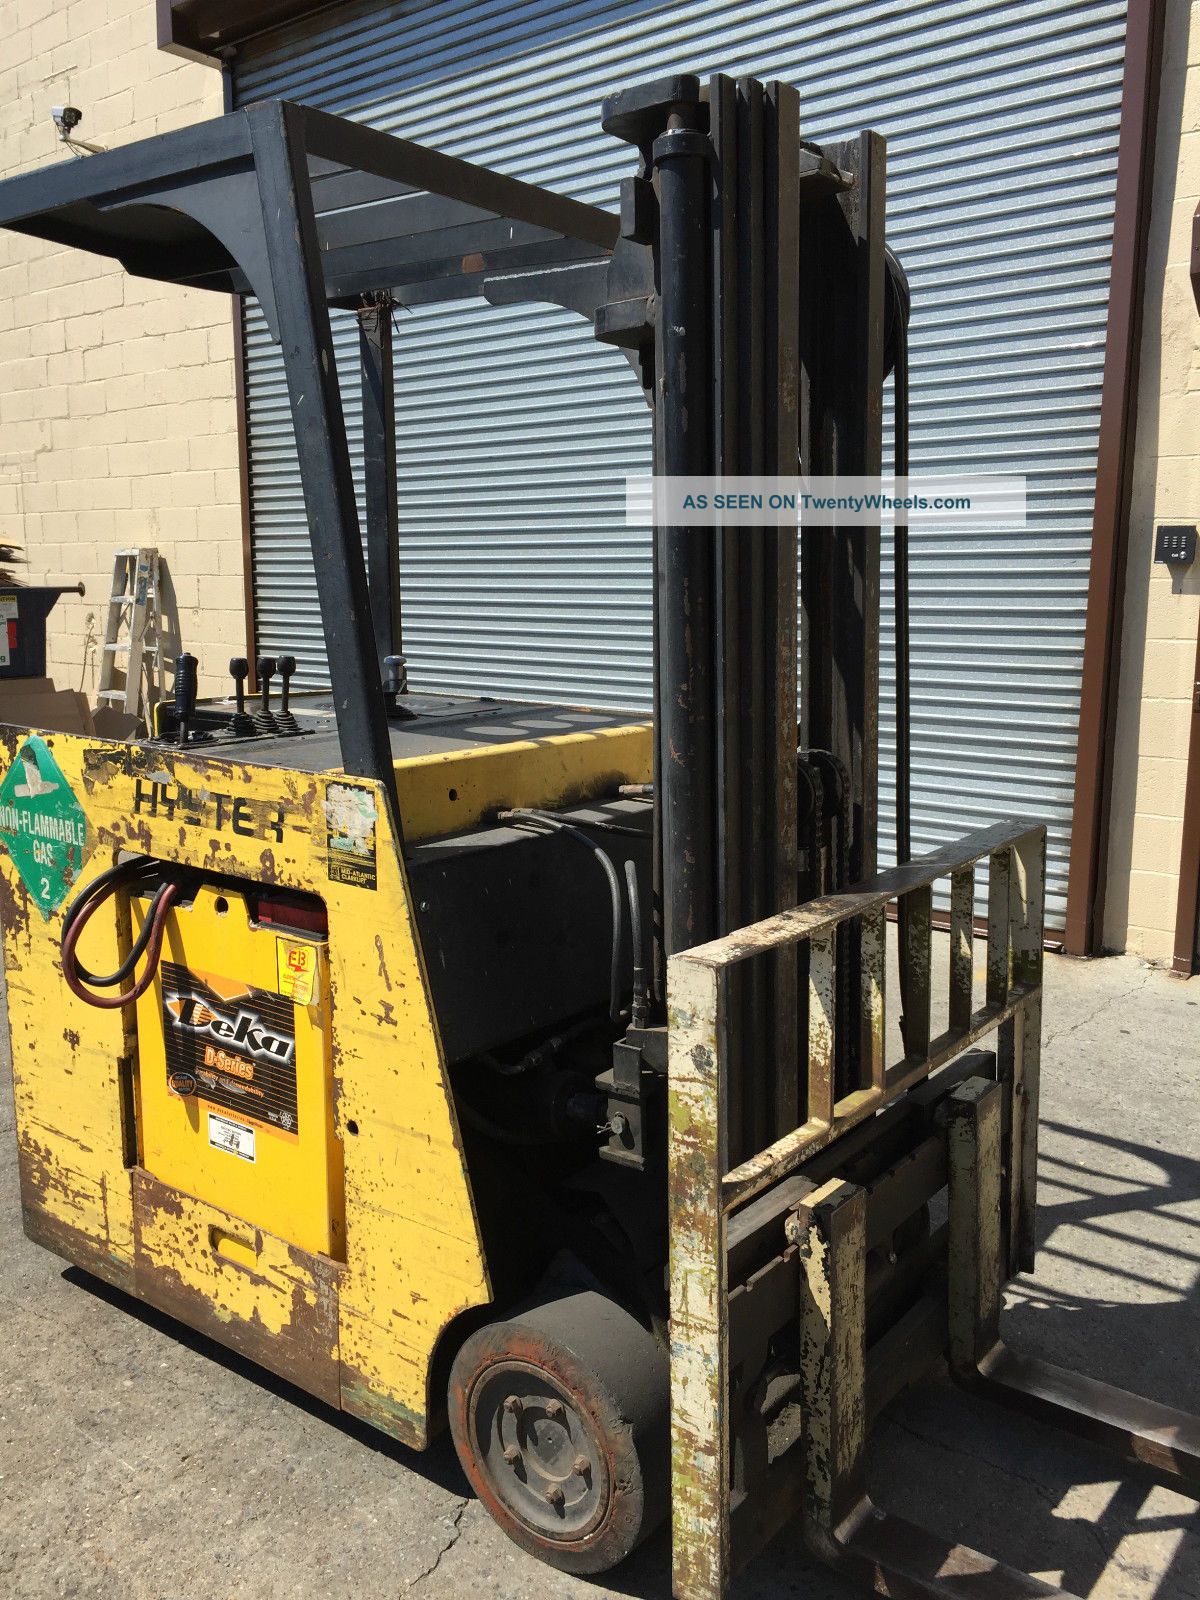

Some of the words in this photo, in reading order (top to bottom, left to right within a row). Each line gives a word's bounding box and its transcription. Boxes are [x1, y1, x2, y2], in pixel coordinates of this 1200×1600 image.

[0, 805, 84, 846] NON-FLAMMABLE
[33, 839, 54, 866] GAS
[41, 877, 51, 899] 2
[168, 996, 290, 1057] Deka
[204, 1046, 254, 1080] D-Series
